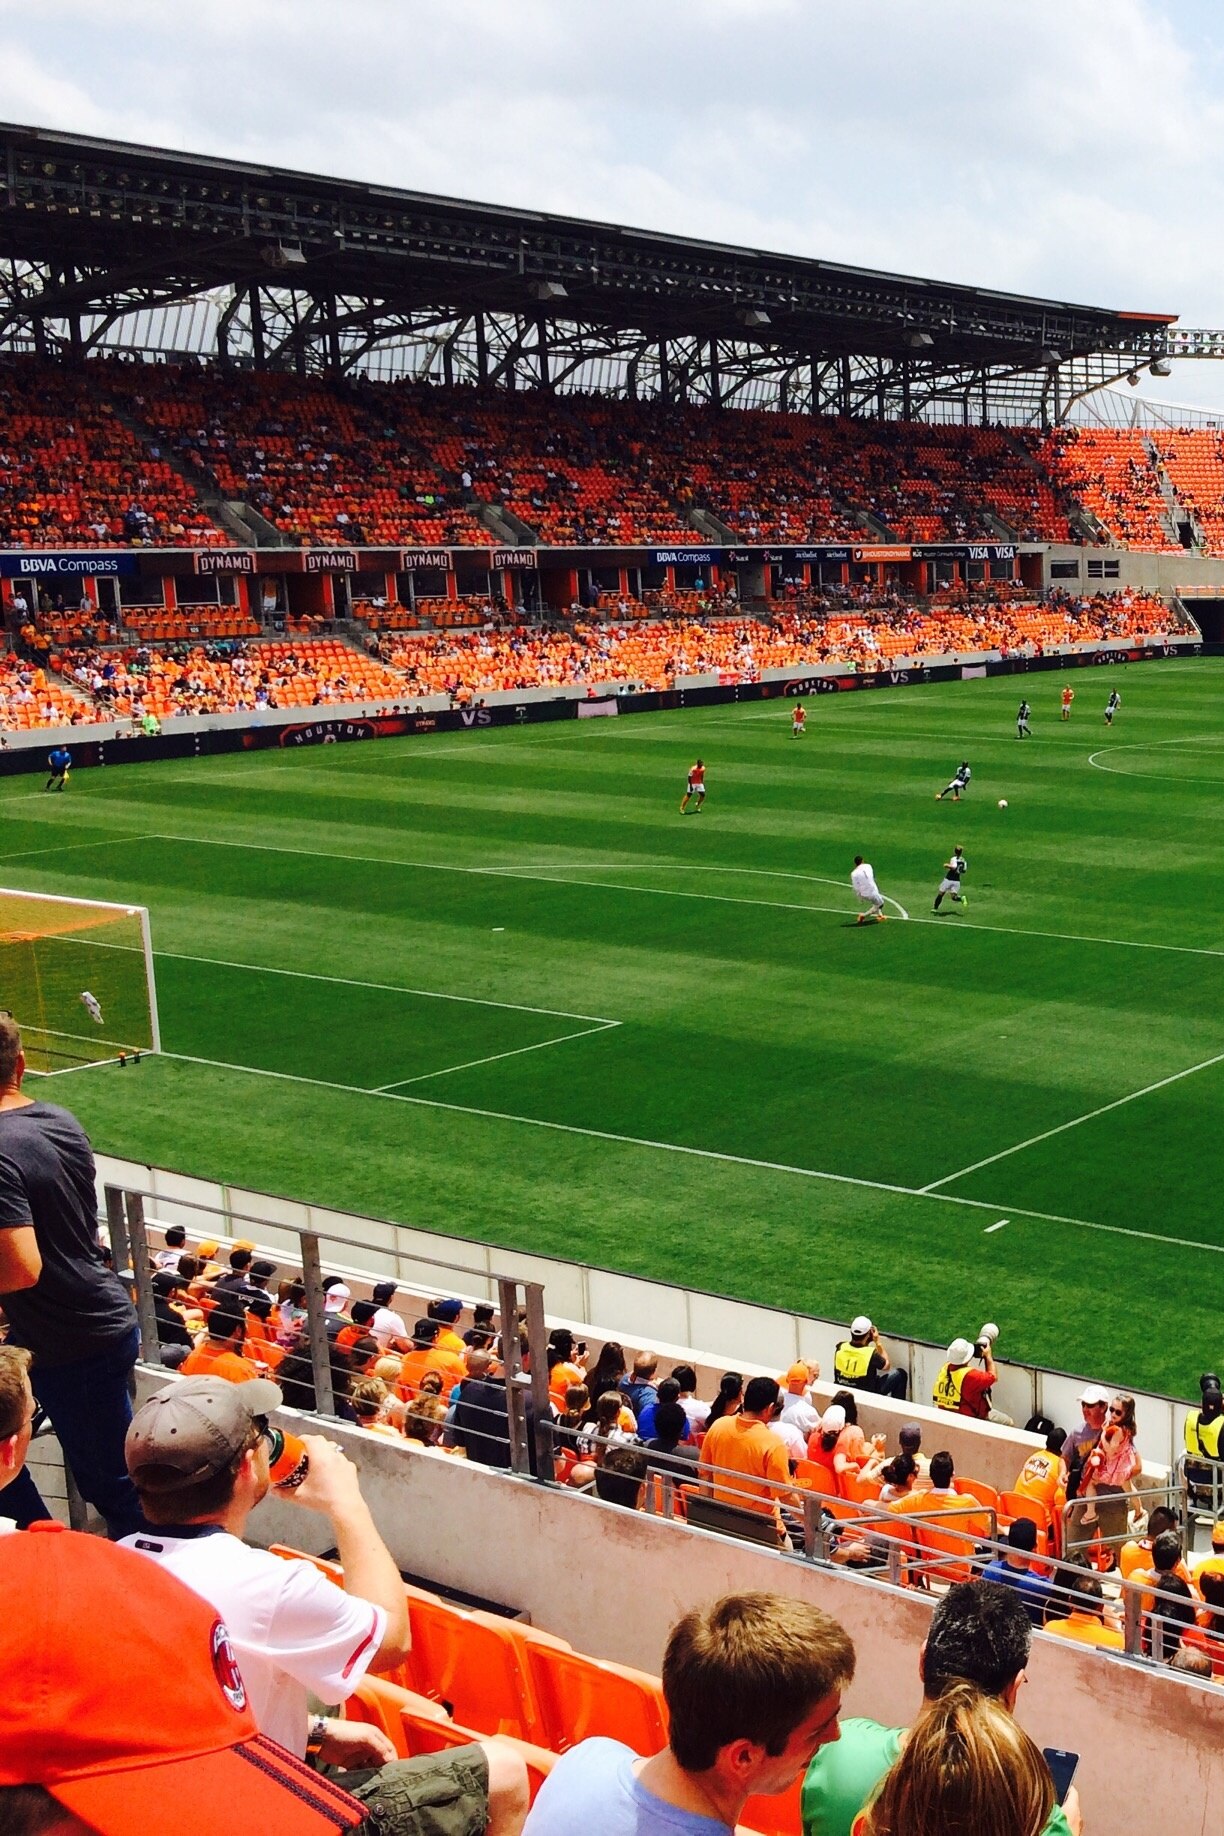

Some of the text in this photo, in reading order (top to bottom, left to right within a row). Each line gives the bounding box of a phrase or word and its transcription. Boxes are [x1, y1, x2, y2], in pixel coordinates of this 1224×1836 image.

[495, 553, 534, 566] DYNAMO
[656, 551, 711, 564] BBVA Compass
[968, 547, 989, 559] VISA
[994, 547, 1015, 559] VISA
[20, 558, 118, 573] BBVA Compass
[200, 556, 250, 571] DYNAMO
[308, 555, 354, 570] DYNAMO
[406, 554, 448, 568] DYNAMO
[1163, 645, 1178, 657] VS
[890, 671, 909, 684] VS
[792, 680, 834, 695] HOUSTON
[461, 708, 492, 726] VS
[294, 723, 365, 744] HOUSTON
[845, 1359, 858, 1373] 11
